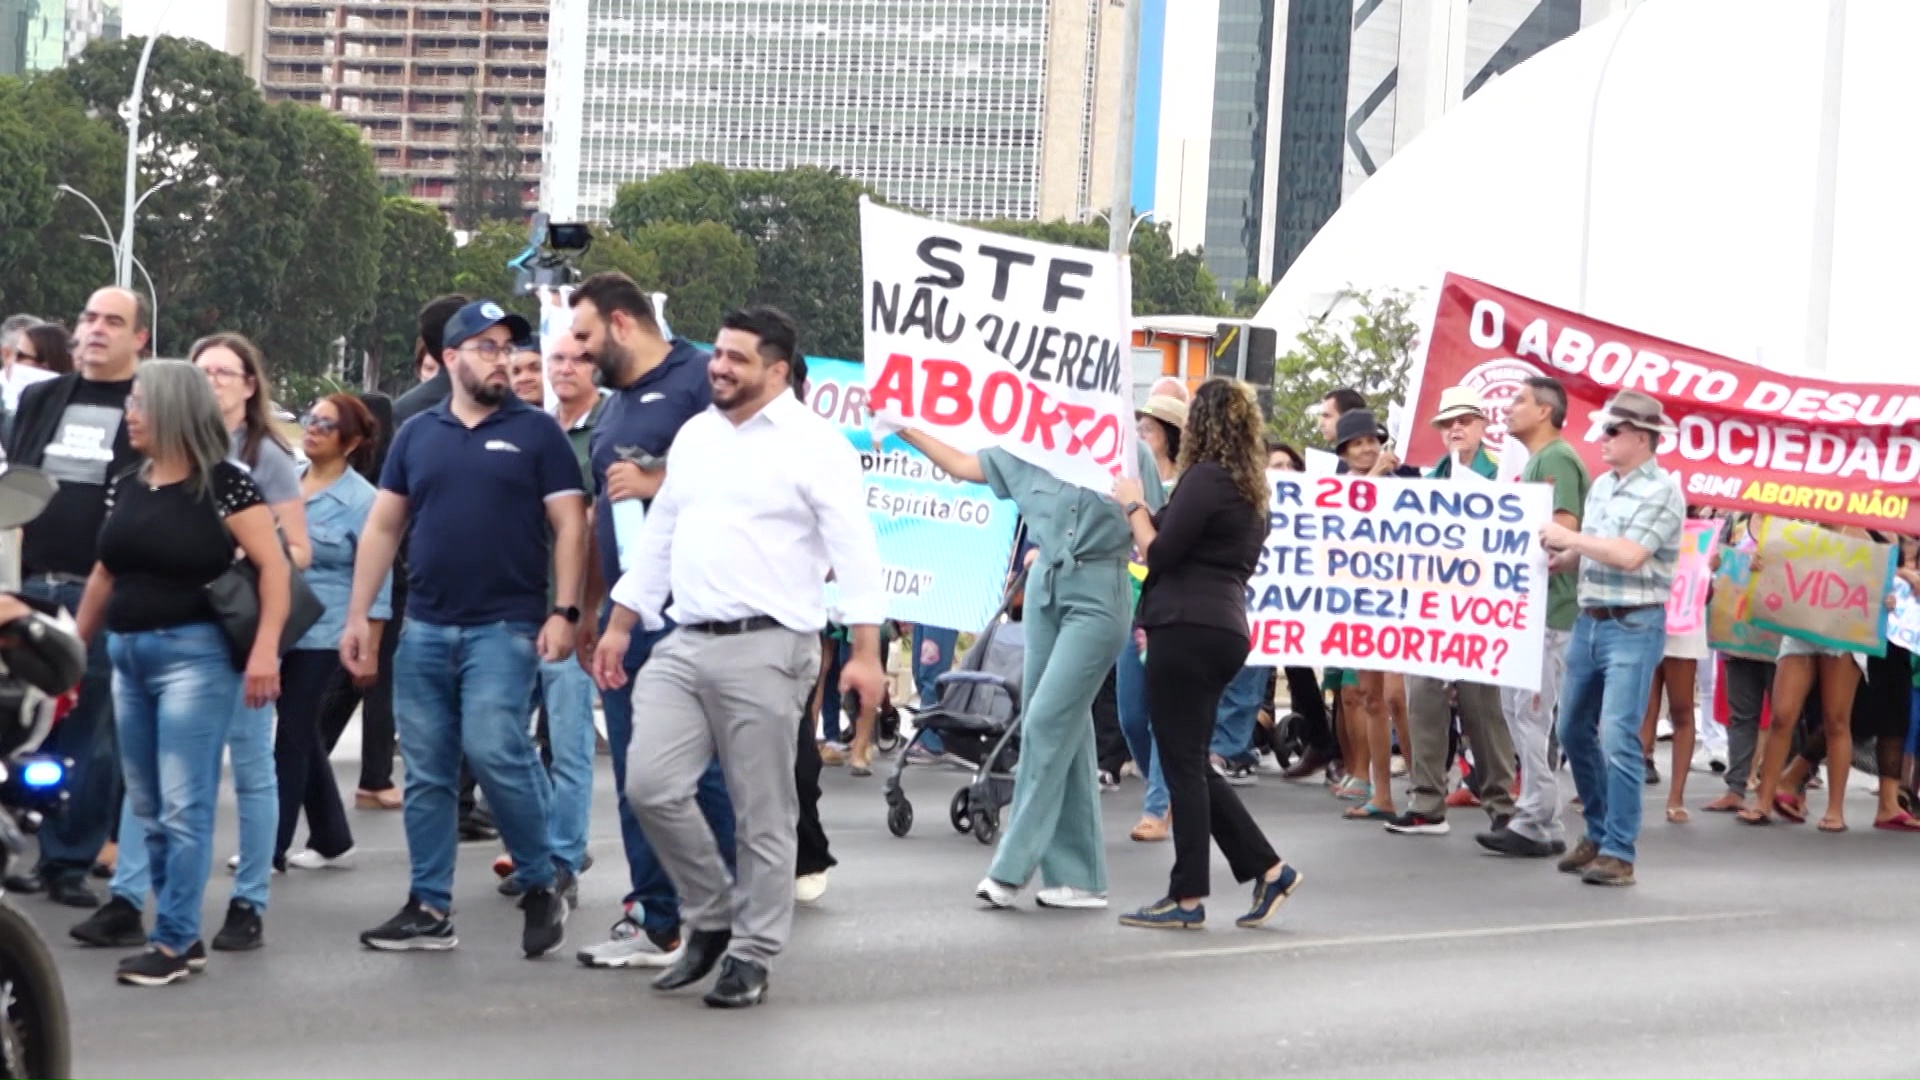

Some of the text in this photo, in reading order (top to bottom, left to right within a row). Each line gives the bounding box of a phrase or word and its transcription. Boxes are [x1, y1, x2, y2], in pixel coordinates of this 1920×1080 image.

[916, 236, 1094, 313] STF
[1469, 299, 1505, 349] O
[1516, 318, 1738, 402] ABORTO
[1656, 415, 1920, 484] OCIEDAD
[866, 486, 990, 525] Espirita/GO
[1392, 489, 1525, 523] ANOS
[1687, 472, 1743, 500] SIM!
[1743, 481, 1844, 513] ABORTO
[1848, 489, 1909, 520] NÃO!
[1270, 511, 1531, 556] PERAMOS UM
[881, 566, 932, 597] IDA"
[1328, 548, 1481, 587] POSITIVO
[1494, 562, 1530, 594] DE
[1785, 560, 1869, 619] VIDA
[1419, 591, 1440, 620] E
[1451, 593, 1529, 630] VOCÊ
[1320, 622, 1510, 677] ABORTAR?
